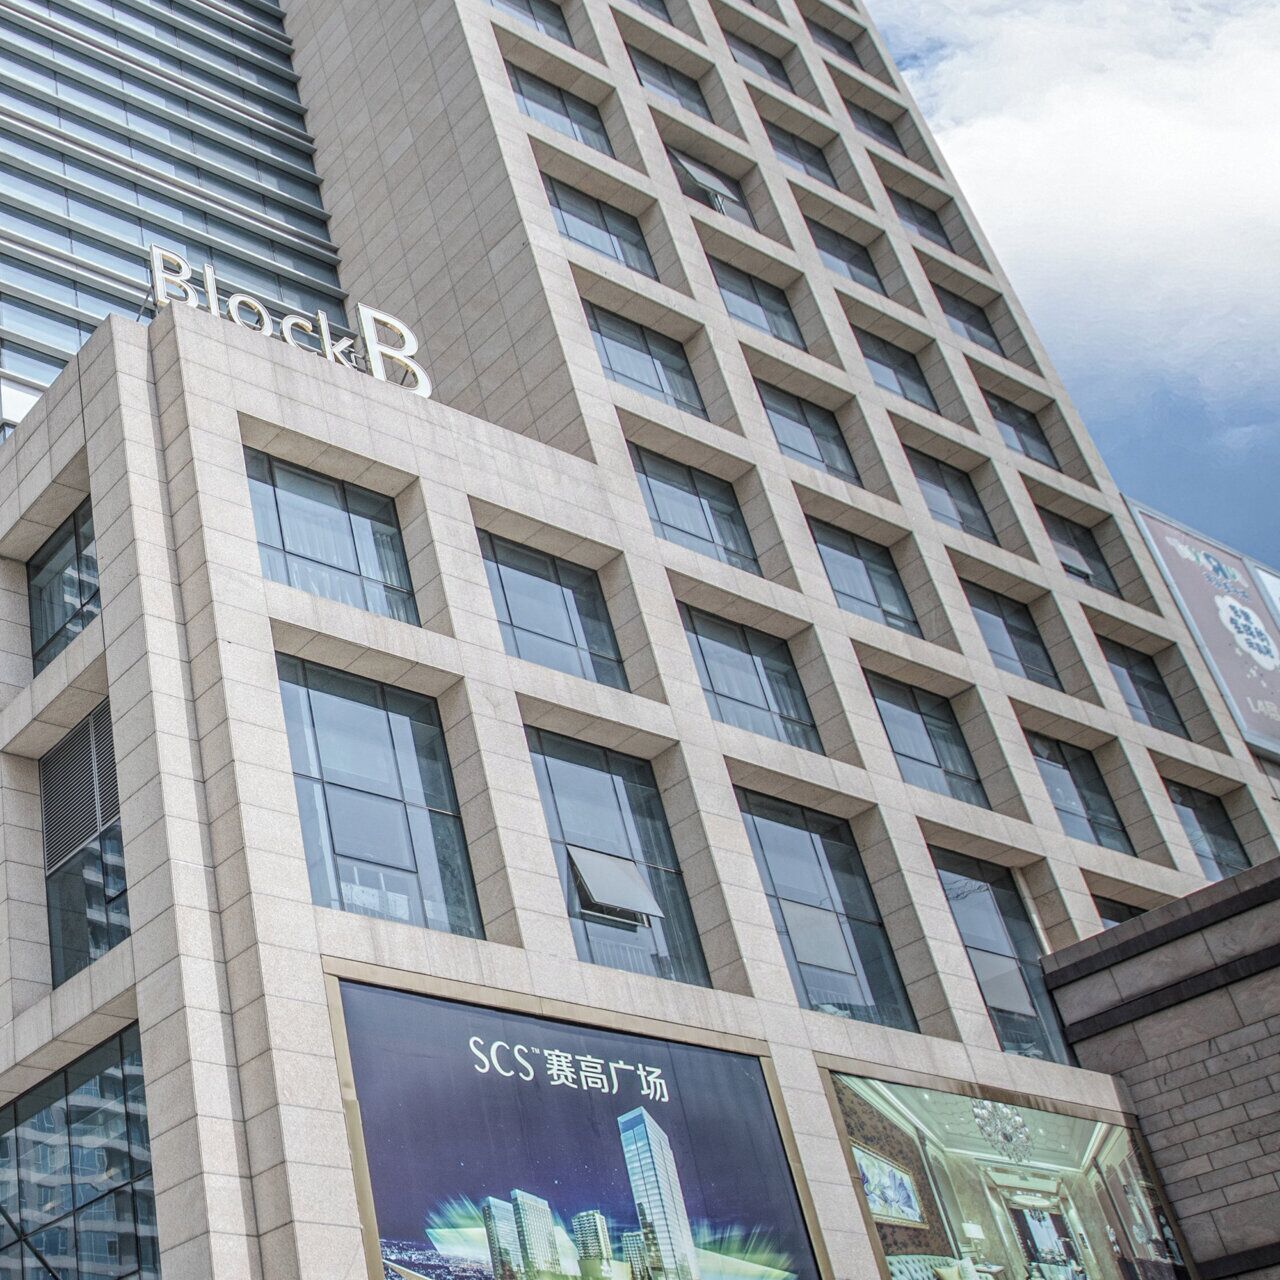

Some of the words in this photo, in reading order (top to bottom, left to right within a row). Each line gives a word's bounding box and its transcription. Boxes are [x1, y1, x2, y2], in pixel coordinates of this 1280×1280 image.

[150, 243, 353, 369] Block
[356, 302, 433, 399] B
[544, 1049, 669, 1102] 赛高广场
